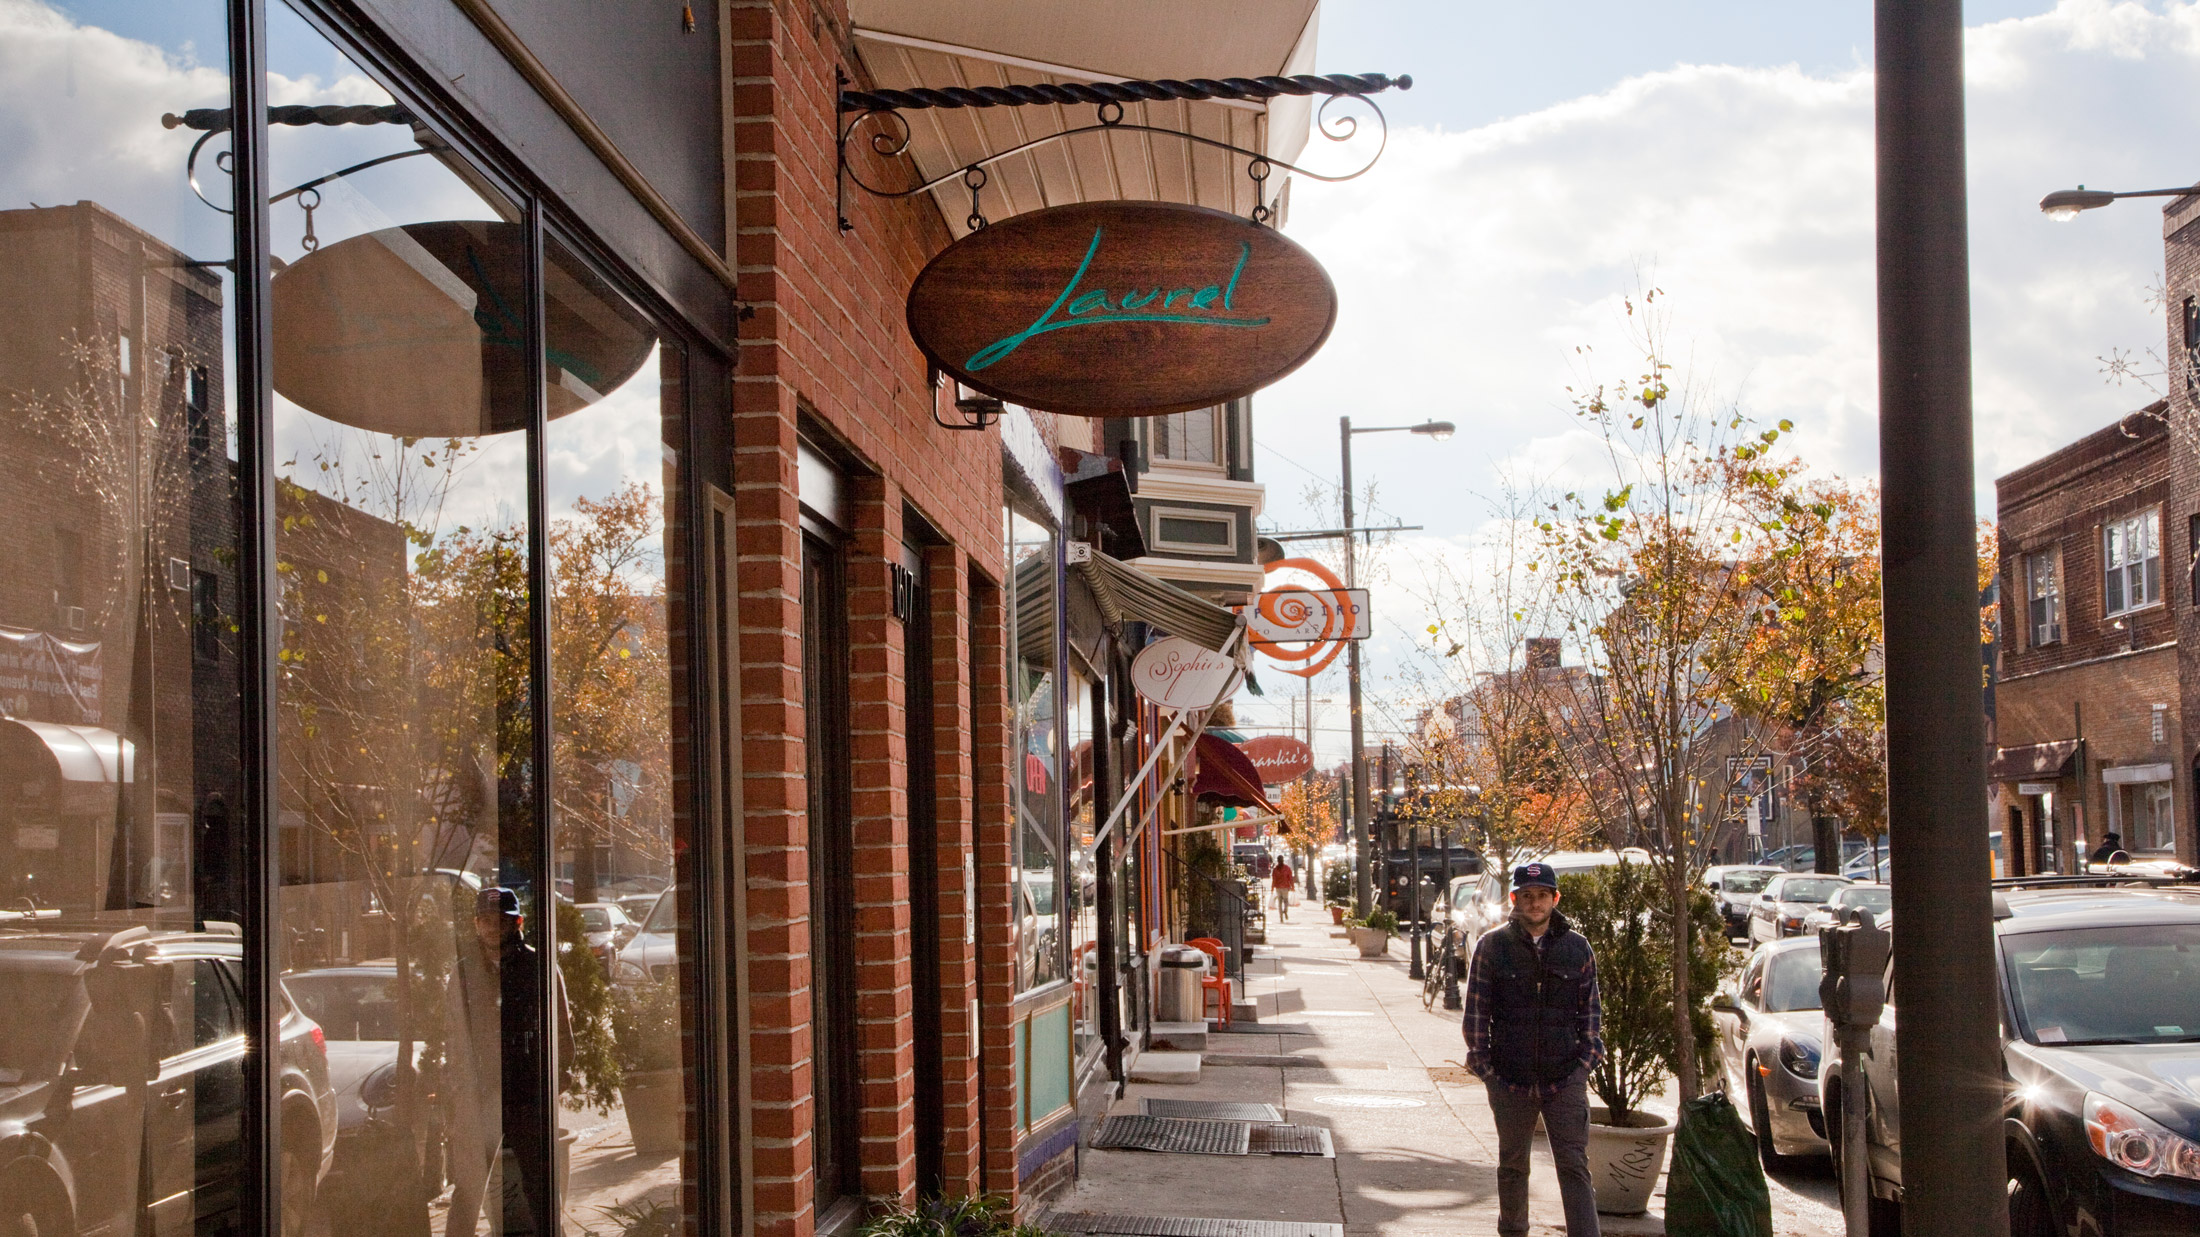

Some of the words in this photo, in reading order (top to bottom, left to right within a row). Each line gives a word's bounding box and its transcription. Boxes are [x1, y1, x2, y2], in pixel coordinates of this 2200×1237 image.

[964, 226, 1272, 372] Laurel
[1243, 747, 1309, 767] rankie's
[1527, 865, 1541, 877] S
